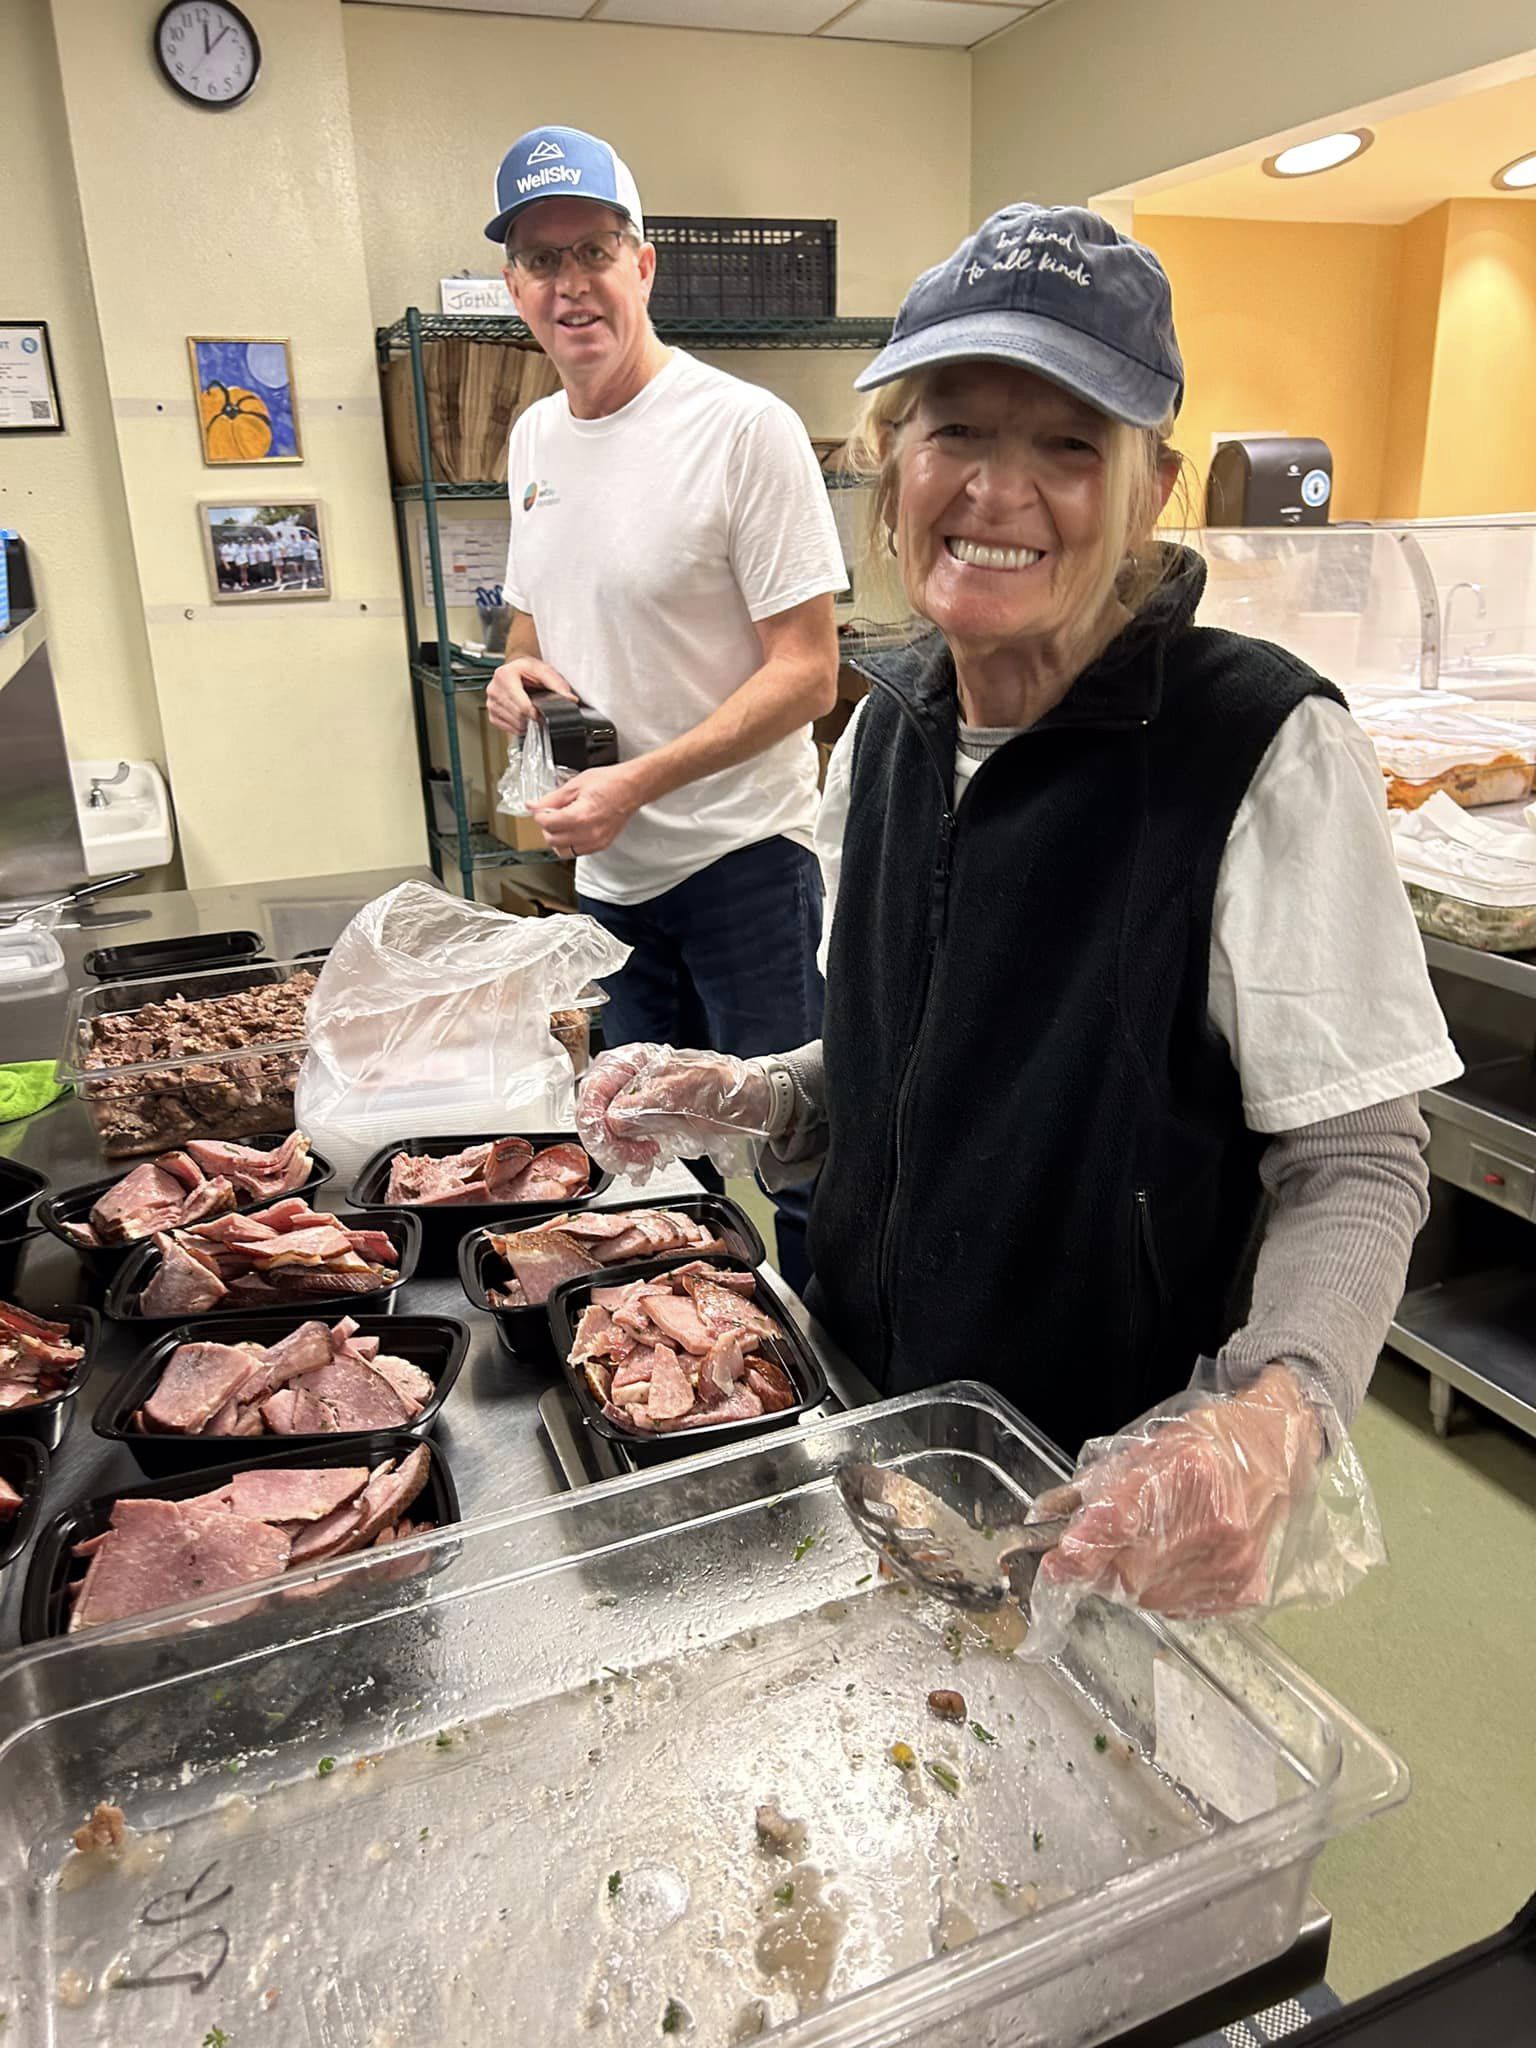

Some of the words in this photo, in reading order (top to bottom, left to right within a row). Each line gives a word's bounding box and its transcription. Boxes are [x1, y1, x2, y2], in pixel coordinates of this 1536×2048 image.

[182, 13, 192, 28] 11
[216, 14, 224, 28] 1
[169, 26, 184, 41] 10
[229, 28, 239, 43] 2
[166, 44, 176, 57] 9
[239, 45, 246, 61] 3
[175, 62, 185, 76] 8
[234, 63, 242, 77] 4
[190, 76, 200, 91] 7
[207, 81, 217, 95] 6
[224, 77, 233, 92] 5
[515, 165, 583, 194] WellSky
[996, 231, 1021, 249] be
[1026, 226, 1074, 252] kind
[964, 260, 987, 286] to
[991, 248, 1035, 270] all
[1038, 252, 1092, 287] kinds
